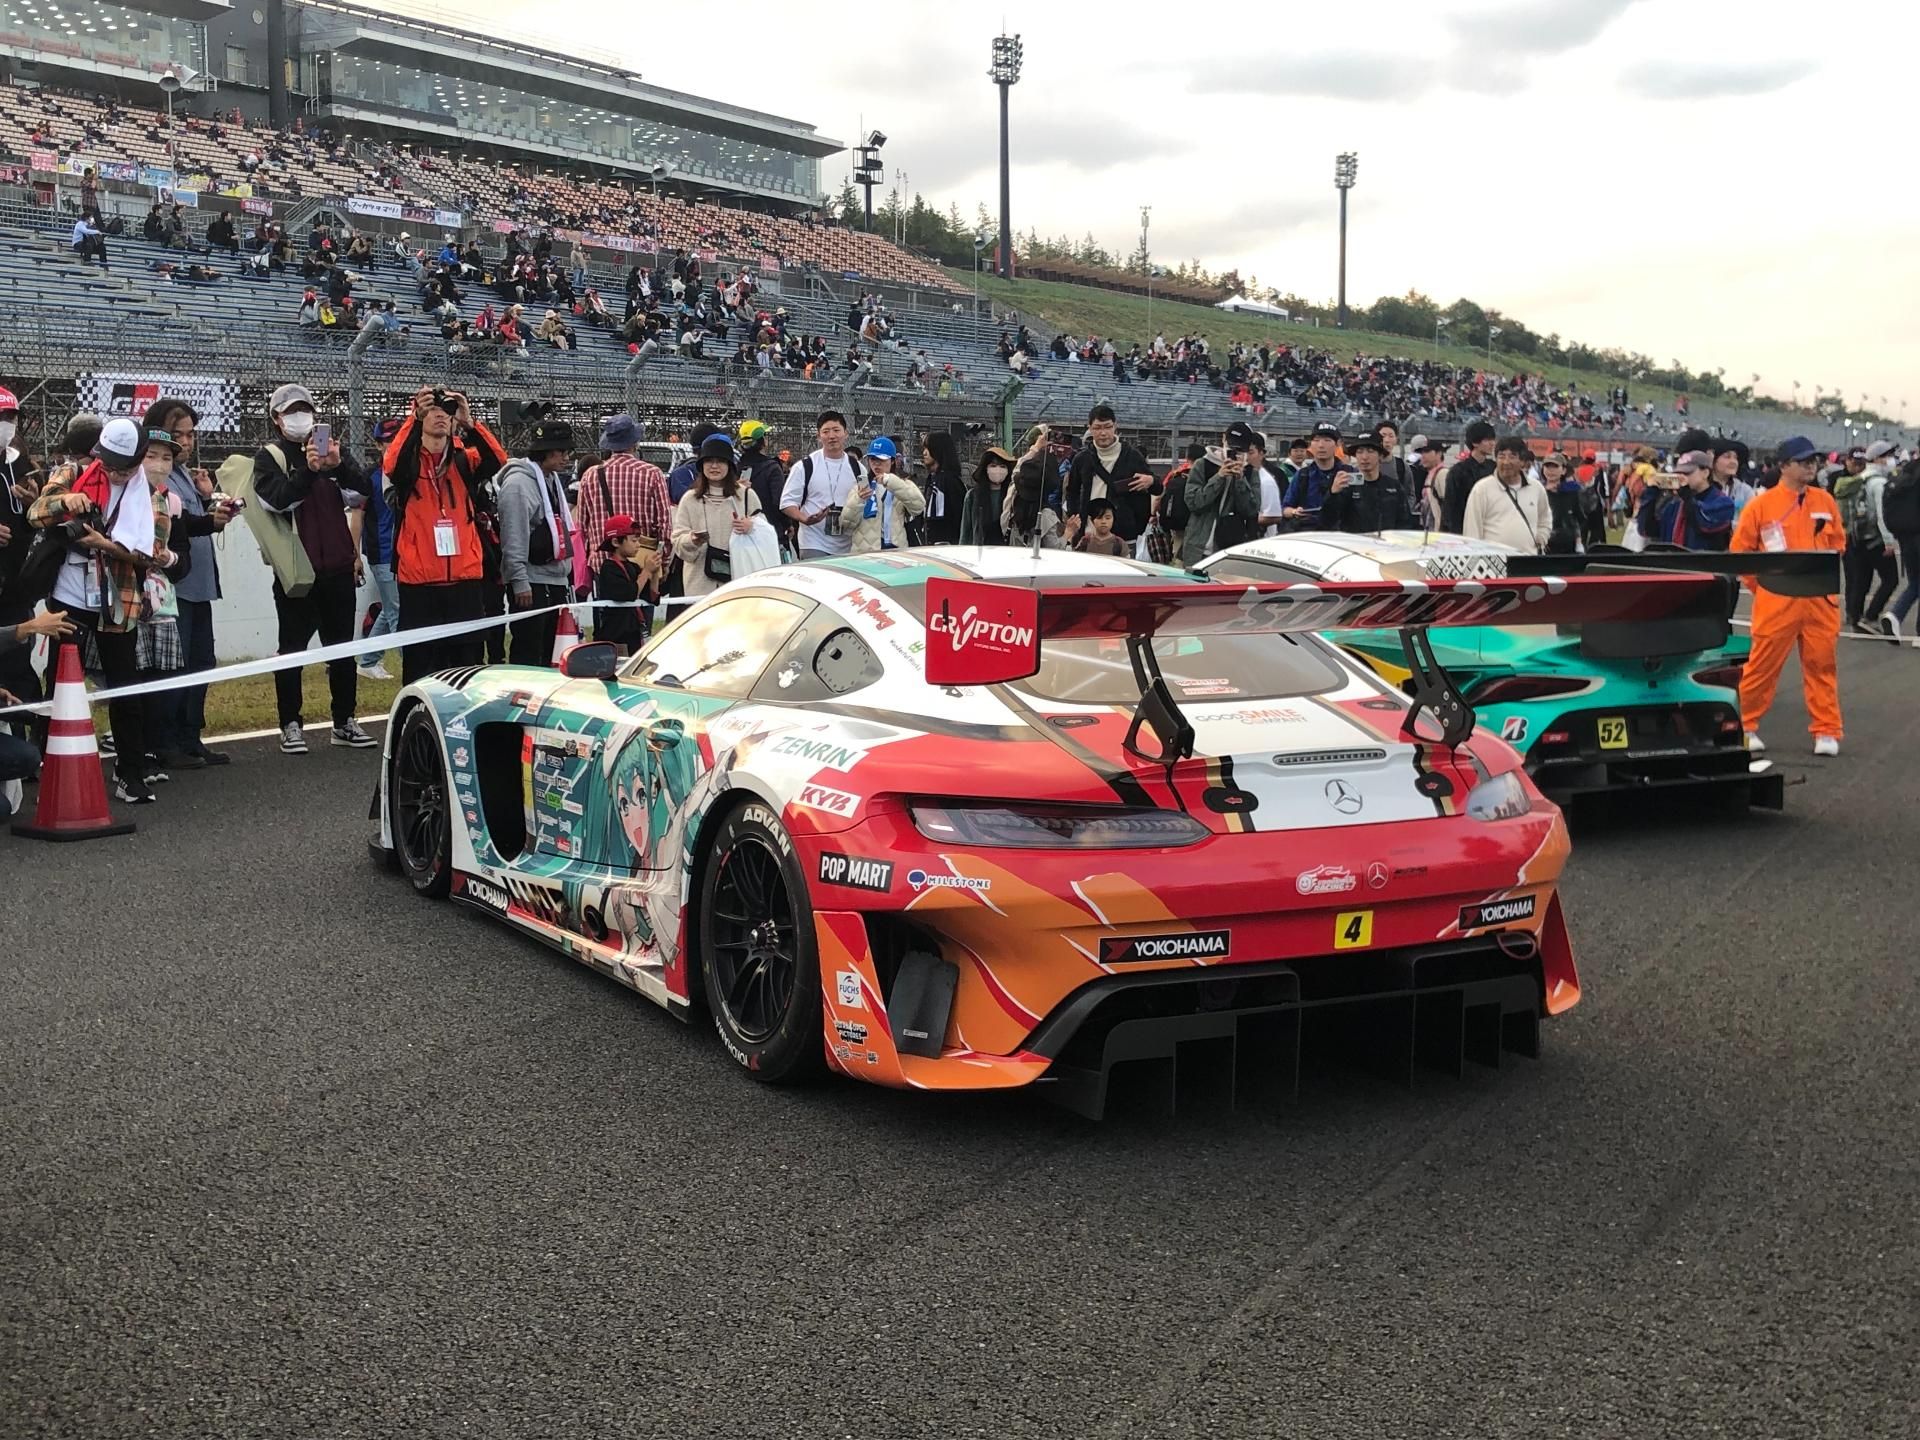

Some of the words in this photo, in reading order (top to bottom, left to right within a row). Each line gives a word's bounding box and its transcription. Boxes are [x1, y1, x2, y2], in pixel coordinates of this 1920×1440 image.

[162, 386, 212, 397] TOYOTA
[930, 606, 1033, 651] CRYPTON
[1601, 722, 1625, 744] 52
[770, 737, 858, 768] ZENRIN
[800, 786, 852, 812] KYB
[742, 807, 791, 857] ADVAN
[820, 855, 846, 882] POP
[848, 860, 891, 889] MART
[927, 876, 991, 889] MILESTONE
[466, 878, 509, 911] YOKOHAMA
[1480, 900, 1534, 923] YOKOHAMA
[1344, 916, 1363, 943] 4
[1135, 938, 1225, 957] YOKOHAMA
[839, 985, 859, 995] FUCHS
